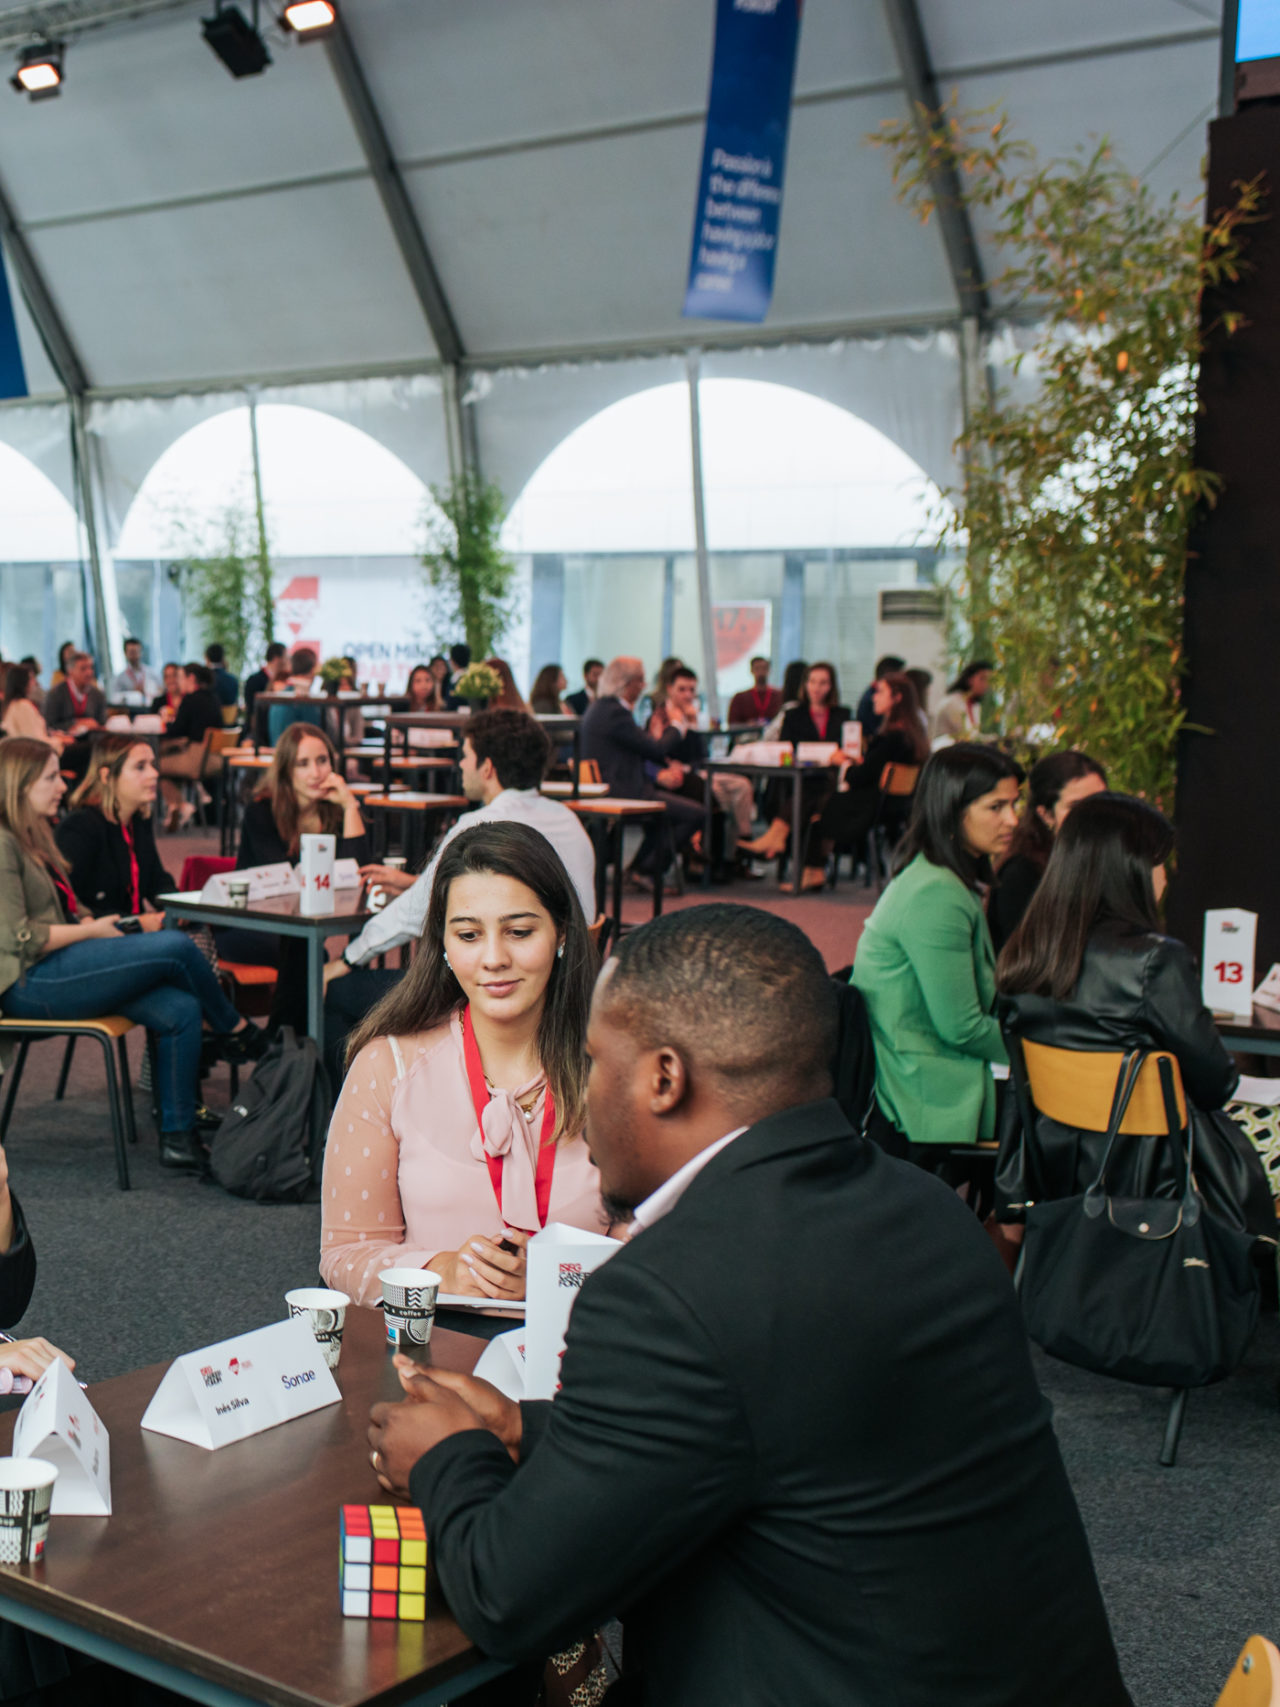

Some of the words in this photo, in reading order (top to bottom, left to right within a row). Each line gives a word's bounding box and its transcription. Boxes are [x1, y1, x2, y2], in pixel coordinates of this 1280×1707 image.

[314, 874, 331, 891] 14
[1213, 961, 1244, 984] 13
[281, 1369, 317, 1390] Sonae
